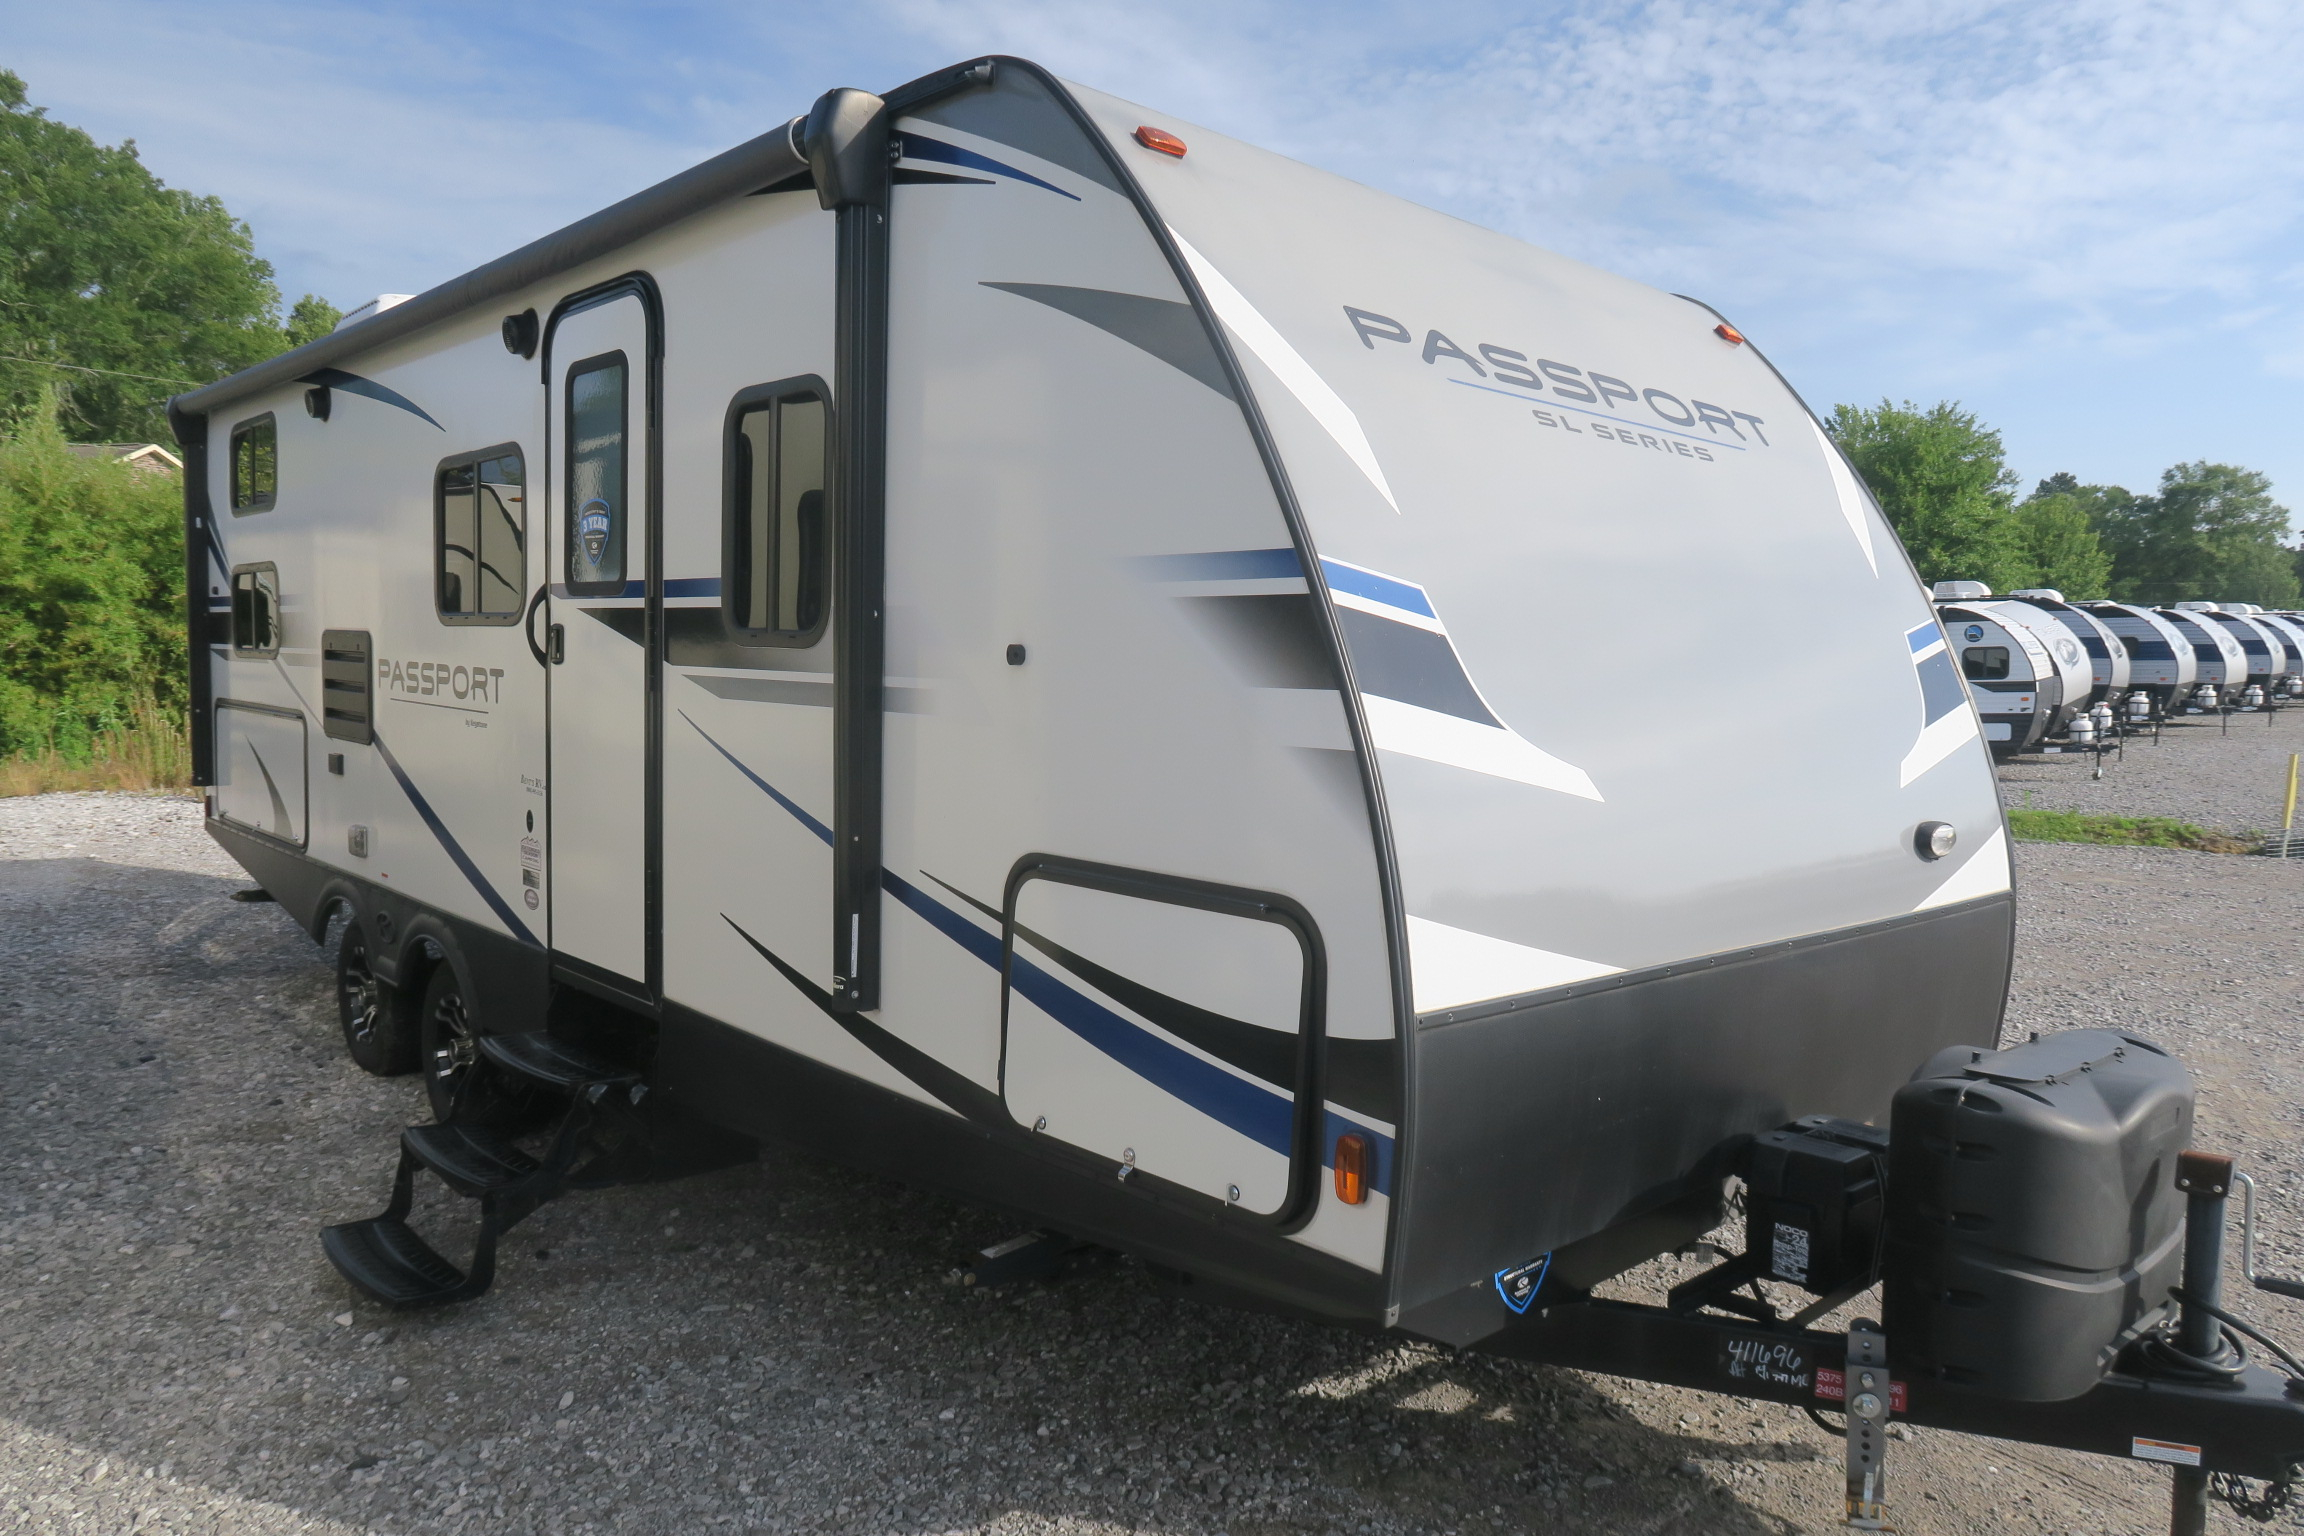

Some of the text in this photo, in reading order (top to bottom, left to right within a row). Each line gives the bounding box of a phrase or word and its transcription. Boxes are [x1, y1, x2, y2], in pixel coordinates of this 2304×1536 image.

[1343, 305, 1769, 447] PASSPORT
[1532, 409, 1714, 462] SL SERIES
[582, 517, 607, 532] 3 YEAR
[378, 658, 504, 704] PASSPORT
[1775, 1222, 1808, 1238] NOCO
[1728, 1340, 1801, 1371] 411696
[1816, 1371, 1842, 1384] 5375
[1816, 1383, 1844, 1397] 240B
